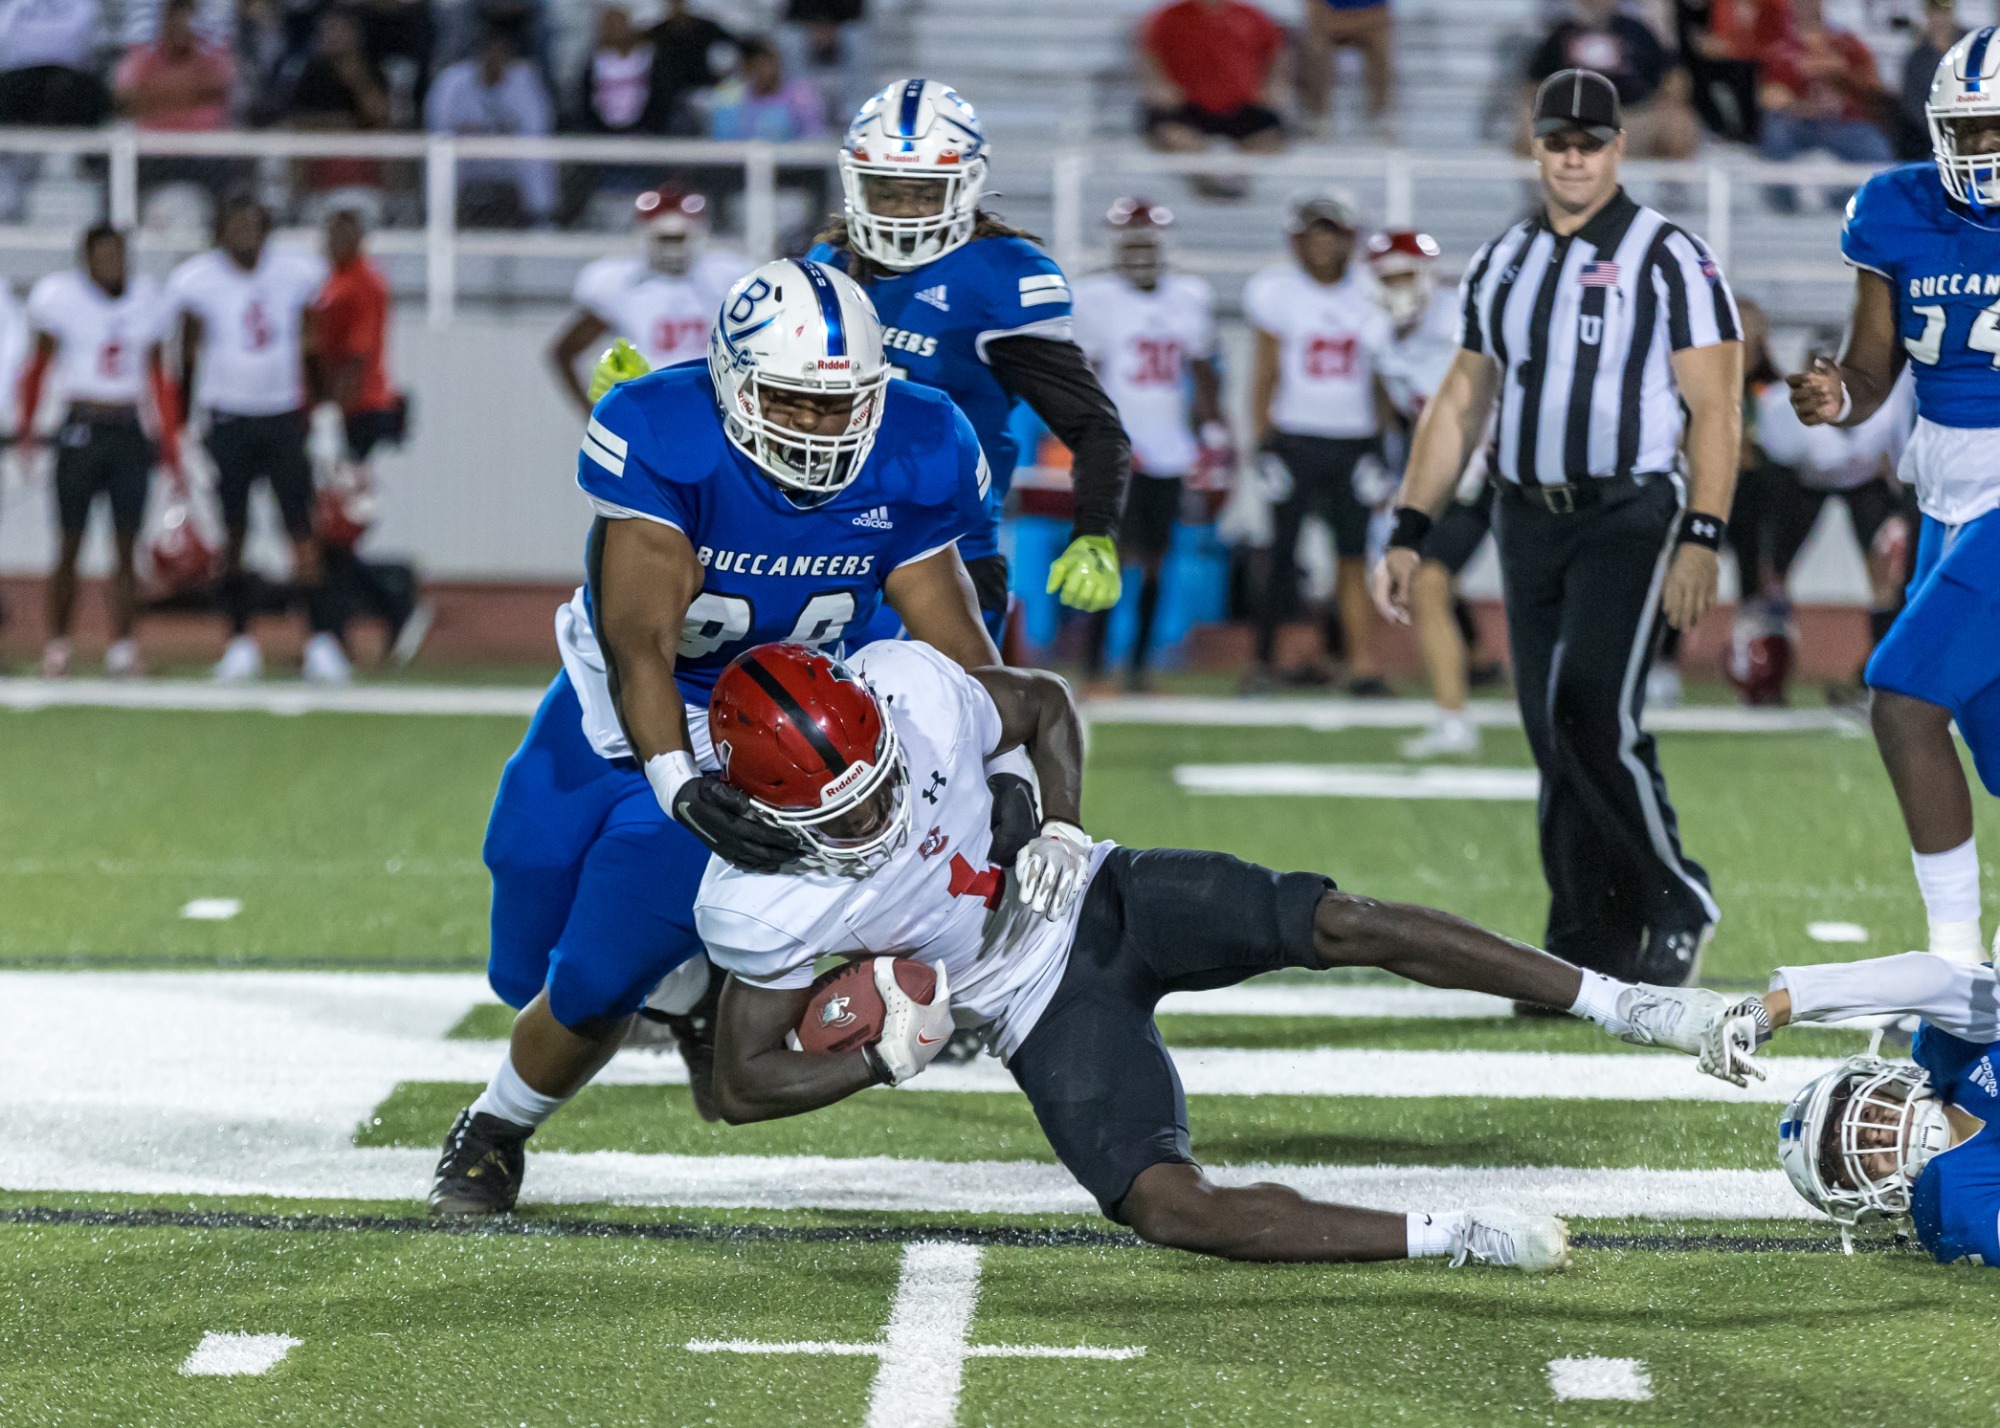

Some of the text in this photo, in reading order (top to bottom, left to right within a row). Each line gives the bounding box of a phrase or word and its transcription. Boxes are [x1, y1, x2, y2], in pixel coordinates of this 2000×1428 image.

[880, 325, 939, 358] EERS
[1579, 314, 1604, 345] U
[817, 360, 850, 370] Riddell
[852, 515, 894, 530] adidas
[697, 545, 875, 577] BUCCANEERS
[825, 764, 865, 798] Riddell
[1980, 1055, 1999, 1098] adidas
